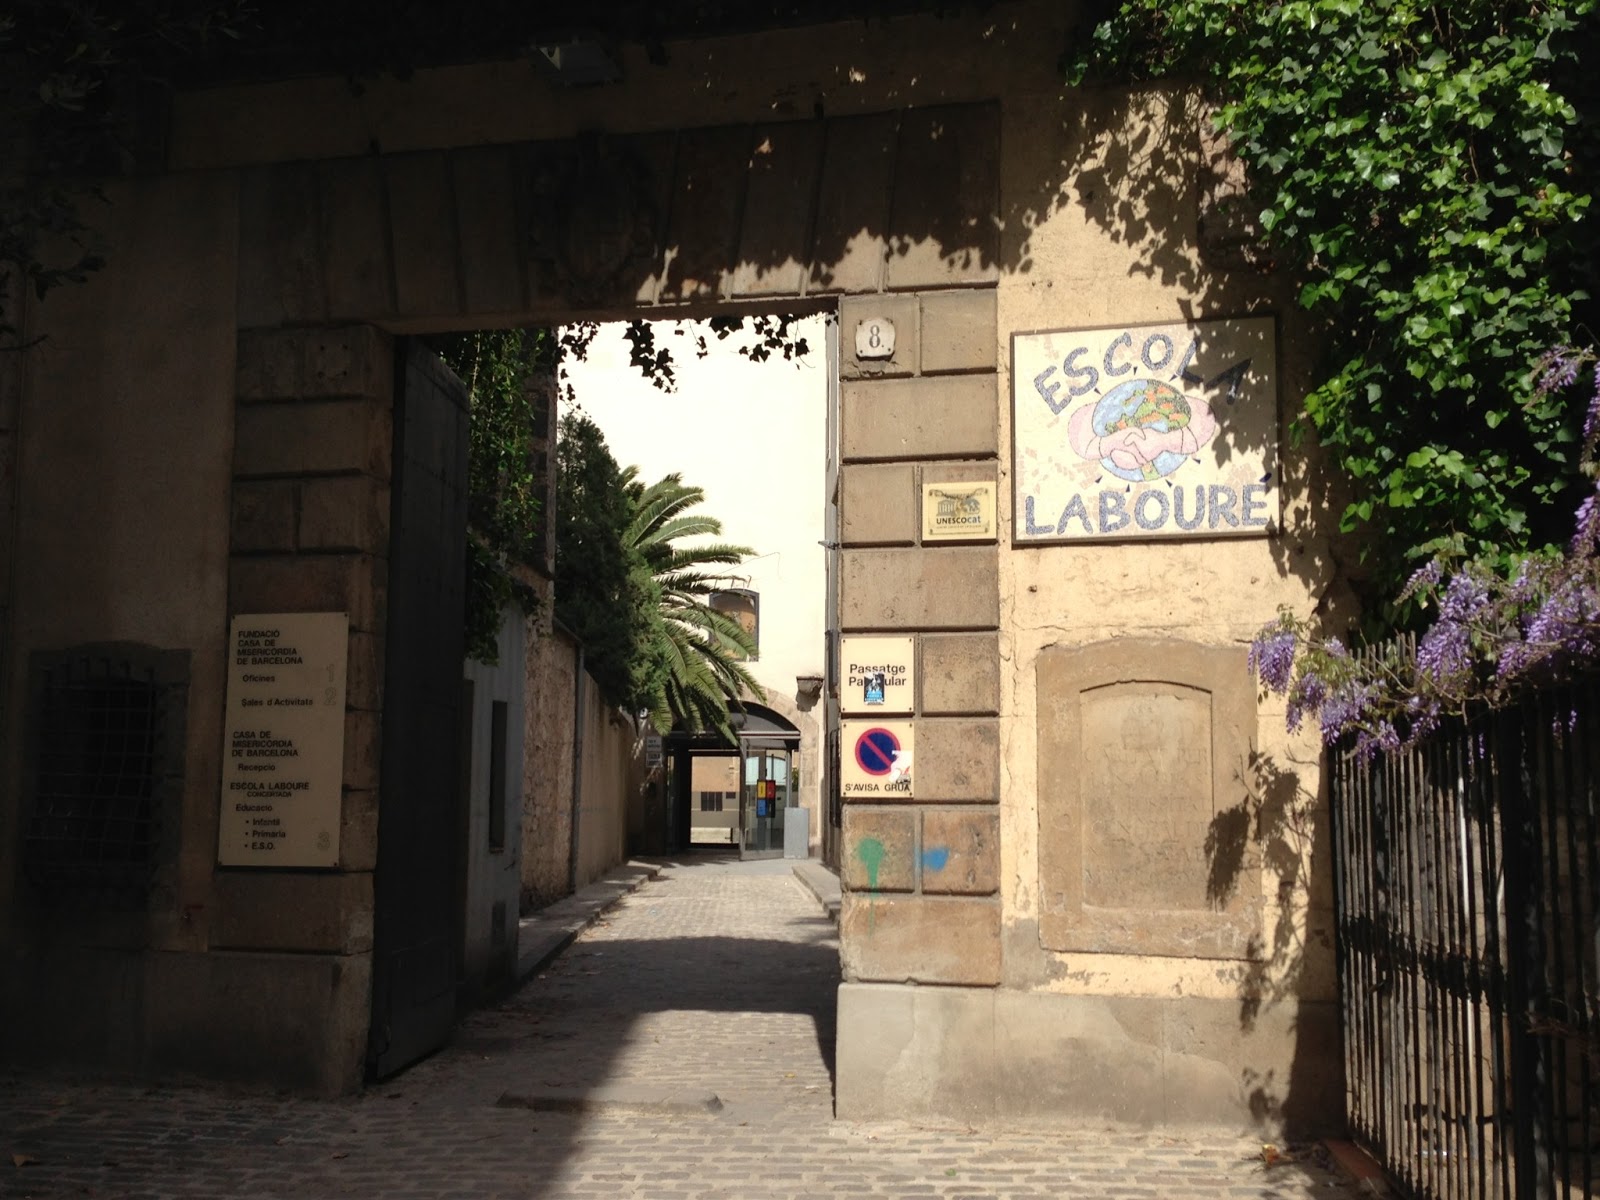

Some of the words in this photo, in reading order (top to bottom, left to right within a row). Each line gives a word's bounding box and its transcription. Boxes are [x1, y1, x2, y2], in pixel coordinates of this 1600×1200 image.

[869, 325, 881, 348] 8
[1034, 332, 1251, 415] ESCOLA
[936, 515, 982, 525] UNESCOcat
[238, 639, 260, 647] CASA
[264, 639, 276, 647] DE
[236, 657, 248, 665] DE
[251, 657, 303, 665] BARCELONA
[850, 664, 906, 675] Passatge
[242, 674, 275, 682] Oficines
[849, 676, 906, 687] Paular
[324, 687, 337, 705] 2
[241, 698, 263, 706] Sales
[233, 731, 256, 739] CASA
[259, 731, 271, 739] DE
[231, 749, 243, 757] DE
[246, 749, 299, 757] BARCELONA
[230, 782, 265, 790] ESCOLA
[845, 783, 880, 792] S'AVISA
[252, 818, 281, 826] Infantil
[252, 830, 286, 838] Primaria
[251, 842, 276, 850] E.S.O.
